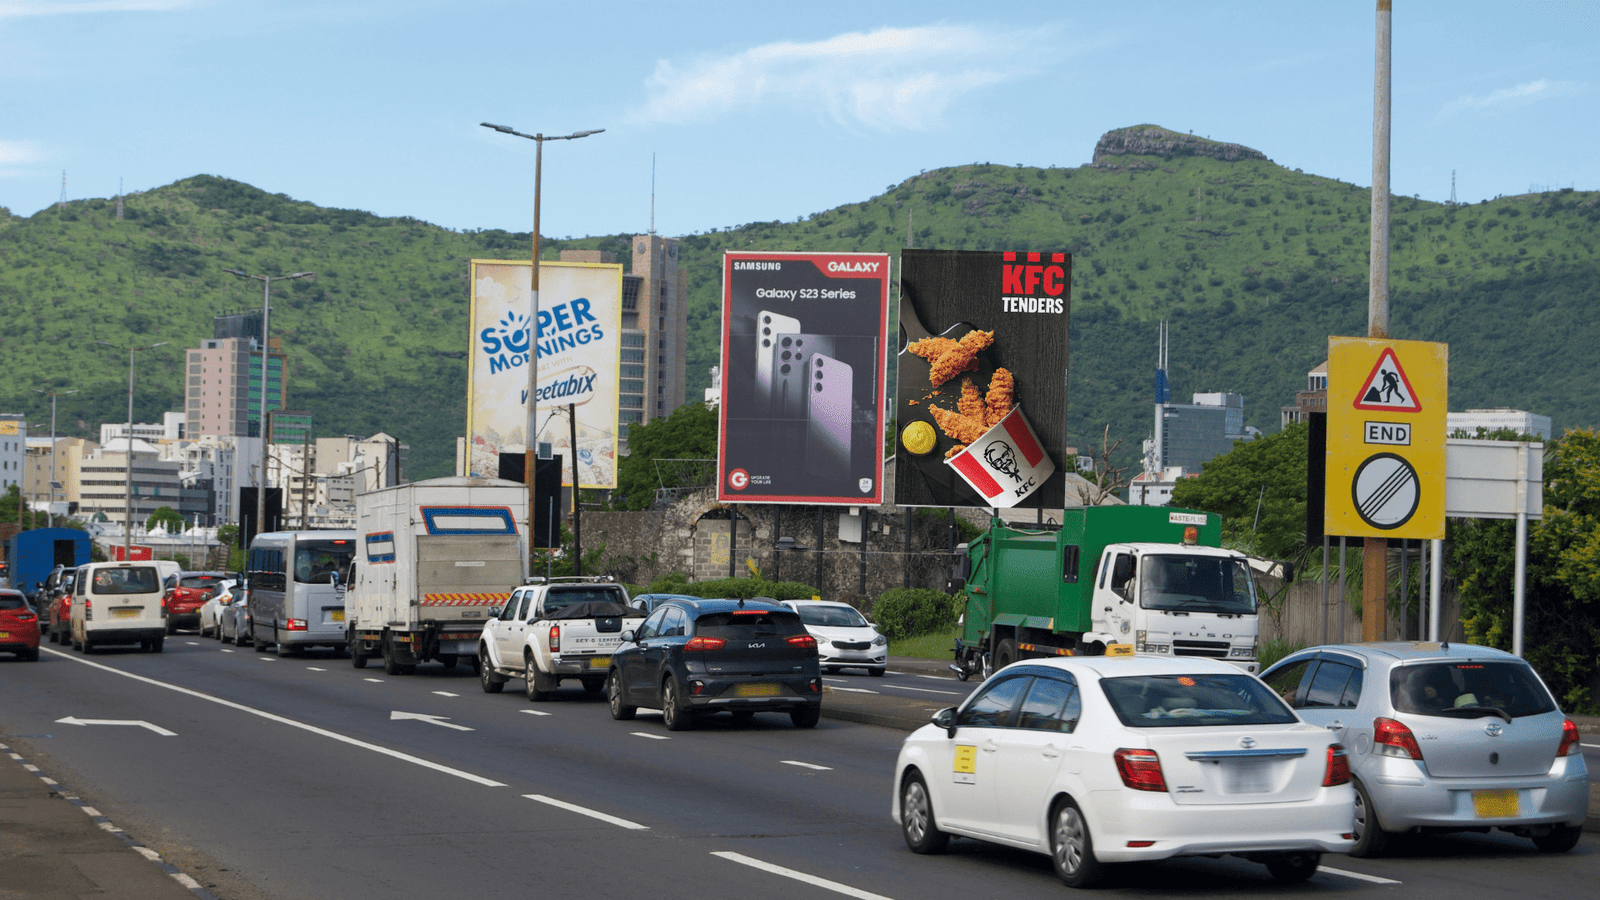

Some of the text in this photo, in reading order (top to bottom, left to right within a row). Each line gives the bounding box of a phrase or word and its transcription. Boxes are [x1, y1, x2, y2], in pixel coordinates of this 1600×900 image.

[734, 262, 781, 271] SAMSUNG
[827, 261, 880, 272] GALAXY
[1002, 265, 1065, 296] KFC
[756, 288, 856, 301] Galaxy S23 Series
[1002, 297, 1064, 314] TENDERS
[480, 297, 597, 354] SUPER
[1369, 425, 1407, 441] END
[1014, 476, 1036, 498] KFC
